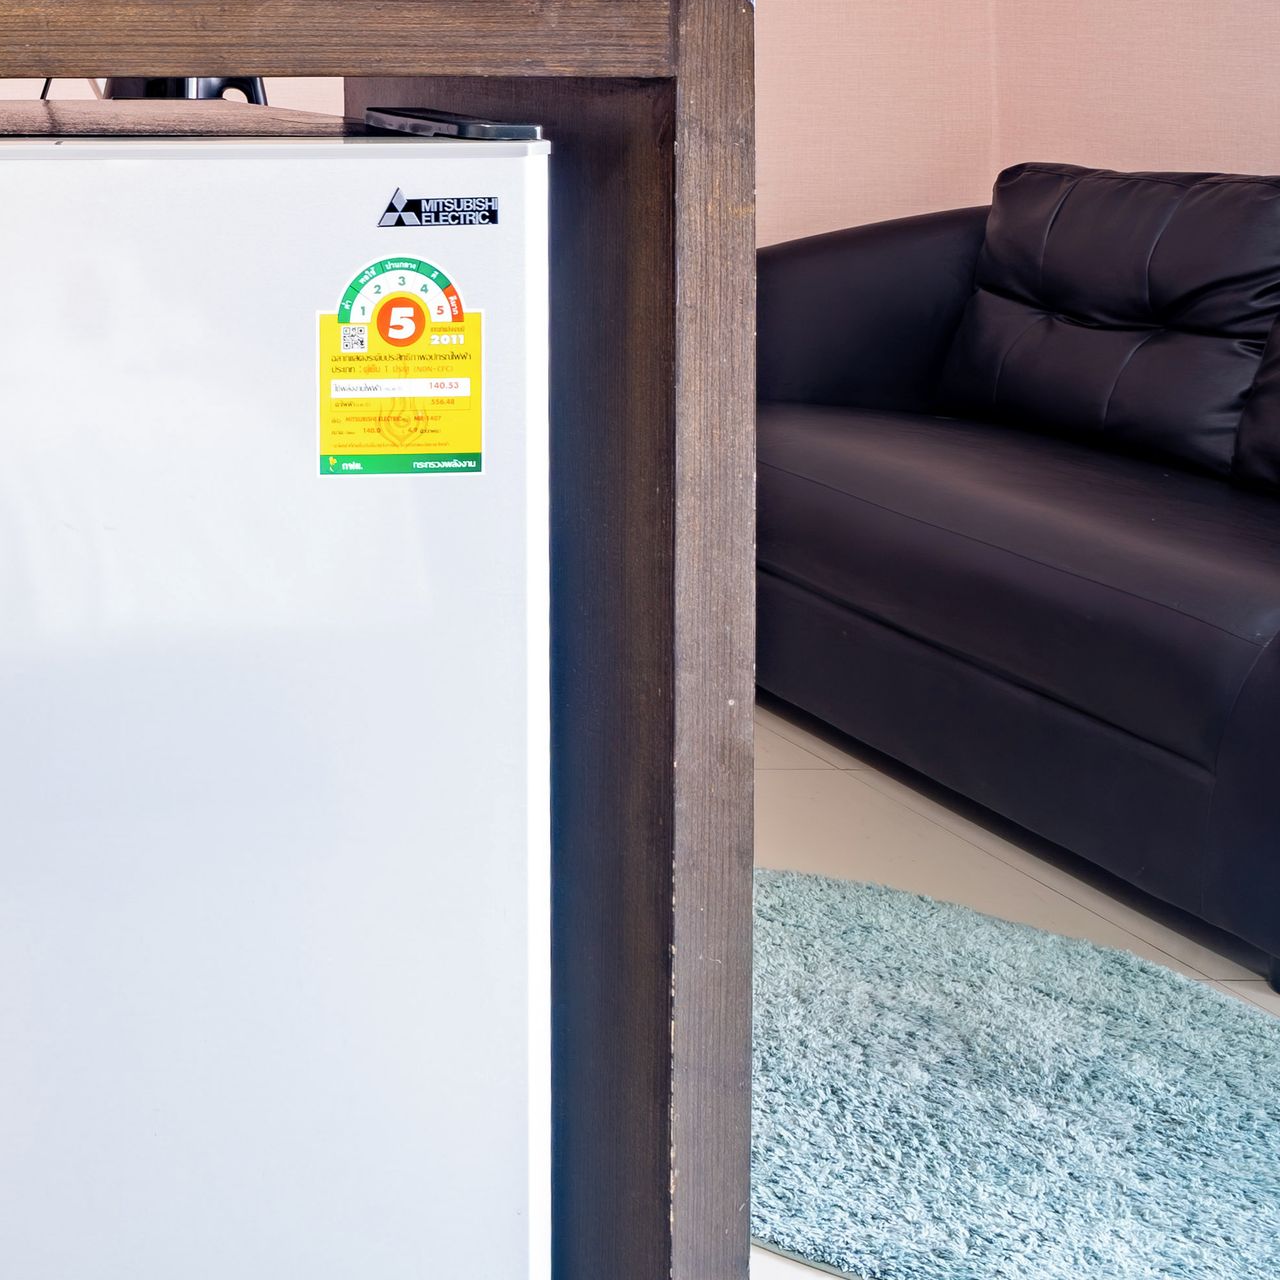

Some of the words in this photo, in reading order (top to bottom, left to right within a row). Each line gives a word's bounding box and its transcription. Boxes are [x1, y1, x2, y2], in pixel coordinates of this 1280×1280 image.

[421, 198, 498, 212] MITSUBISHI
[421, 211, 489, 225] ELECTRIC
[398, 276, 406, 286] 3
[373, 284, 382, 294] 2
[420, 283, 429, 294] 4
[360, 306, 366, 316] 1
[436, 306, 444, 315] 5
[387, 307, 416, 339] 5
[431, 334, 464, 345] 2011
